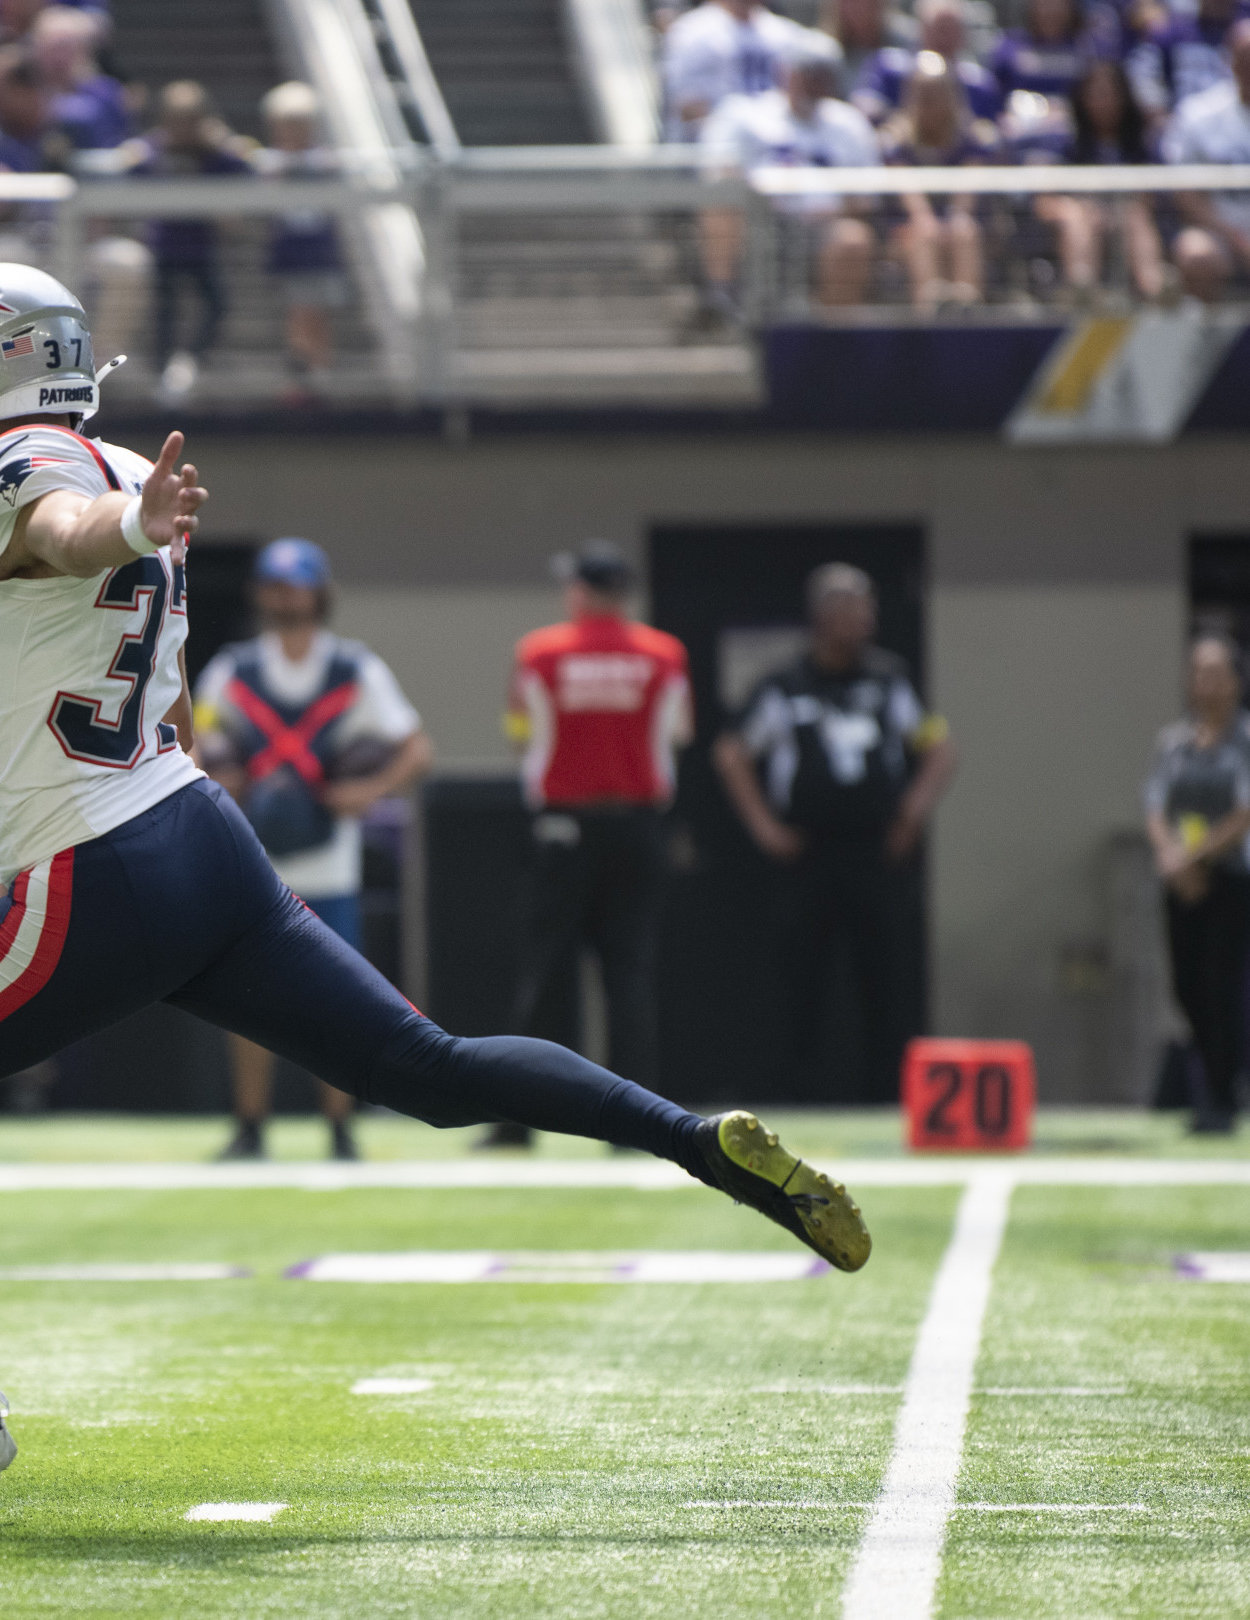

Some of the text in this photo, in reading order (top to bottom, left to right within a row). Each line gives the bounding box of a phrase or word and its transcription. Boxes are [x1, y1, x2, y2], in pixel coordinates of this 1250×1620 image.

[43, 338, 82, 369] 37
[39, 385, 93, 407] PATRIOTS
[924, 1062, 1012, 1137] 20
